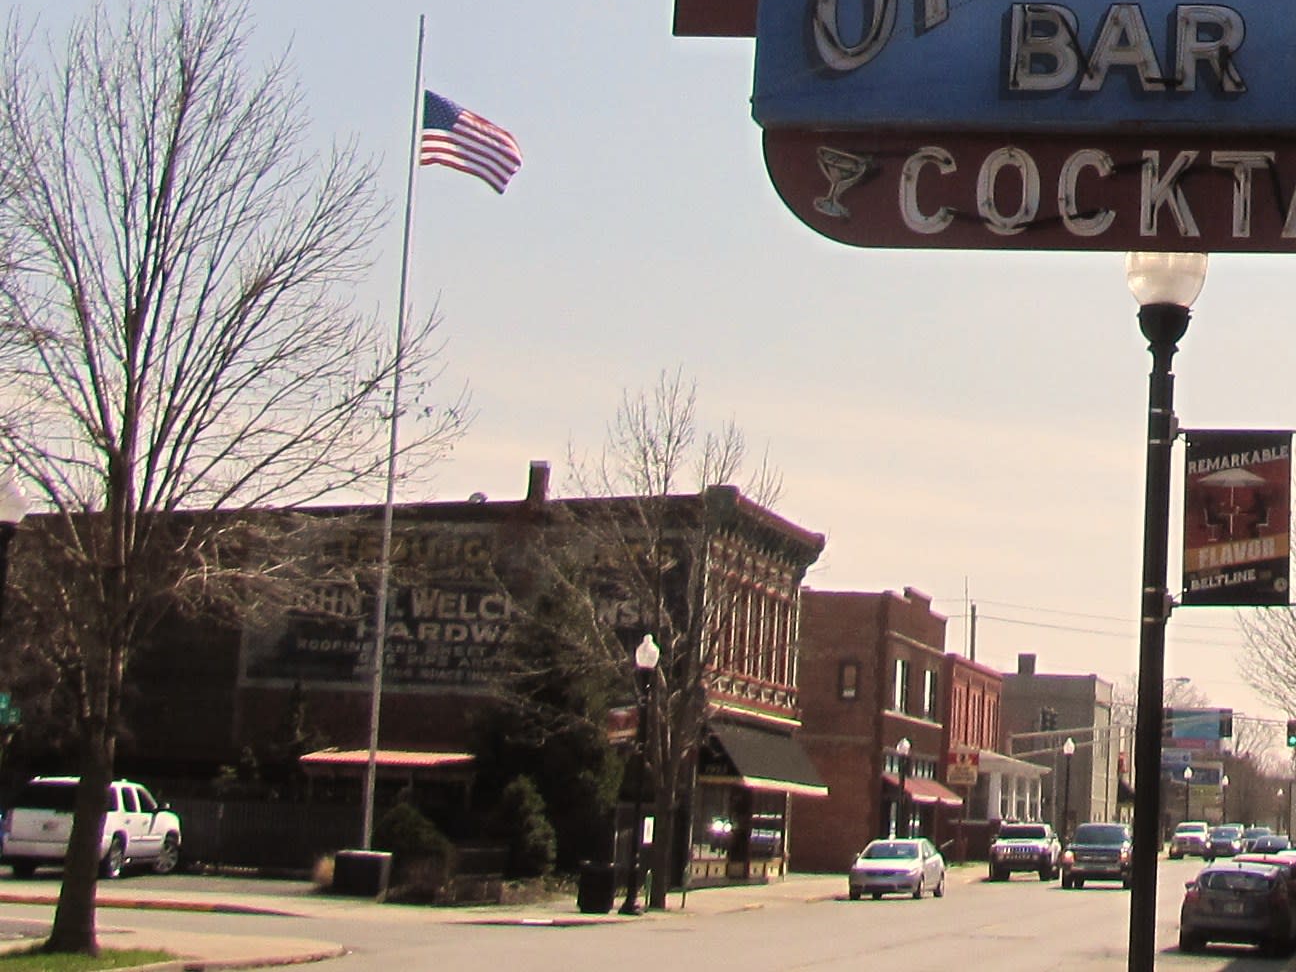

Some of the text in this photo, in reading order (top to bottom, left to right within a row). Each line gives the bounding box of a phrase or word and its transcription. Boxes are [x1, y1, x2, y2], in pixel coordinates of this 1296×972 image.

[1009, 3, 1245, 92] BAR
[1188, 445, 1289, 474] REMARKABLE
[1199, 537, 1276, 568] FLAVOR
[1191, 569, 1257, 590] BELTLINE
